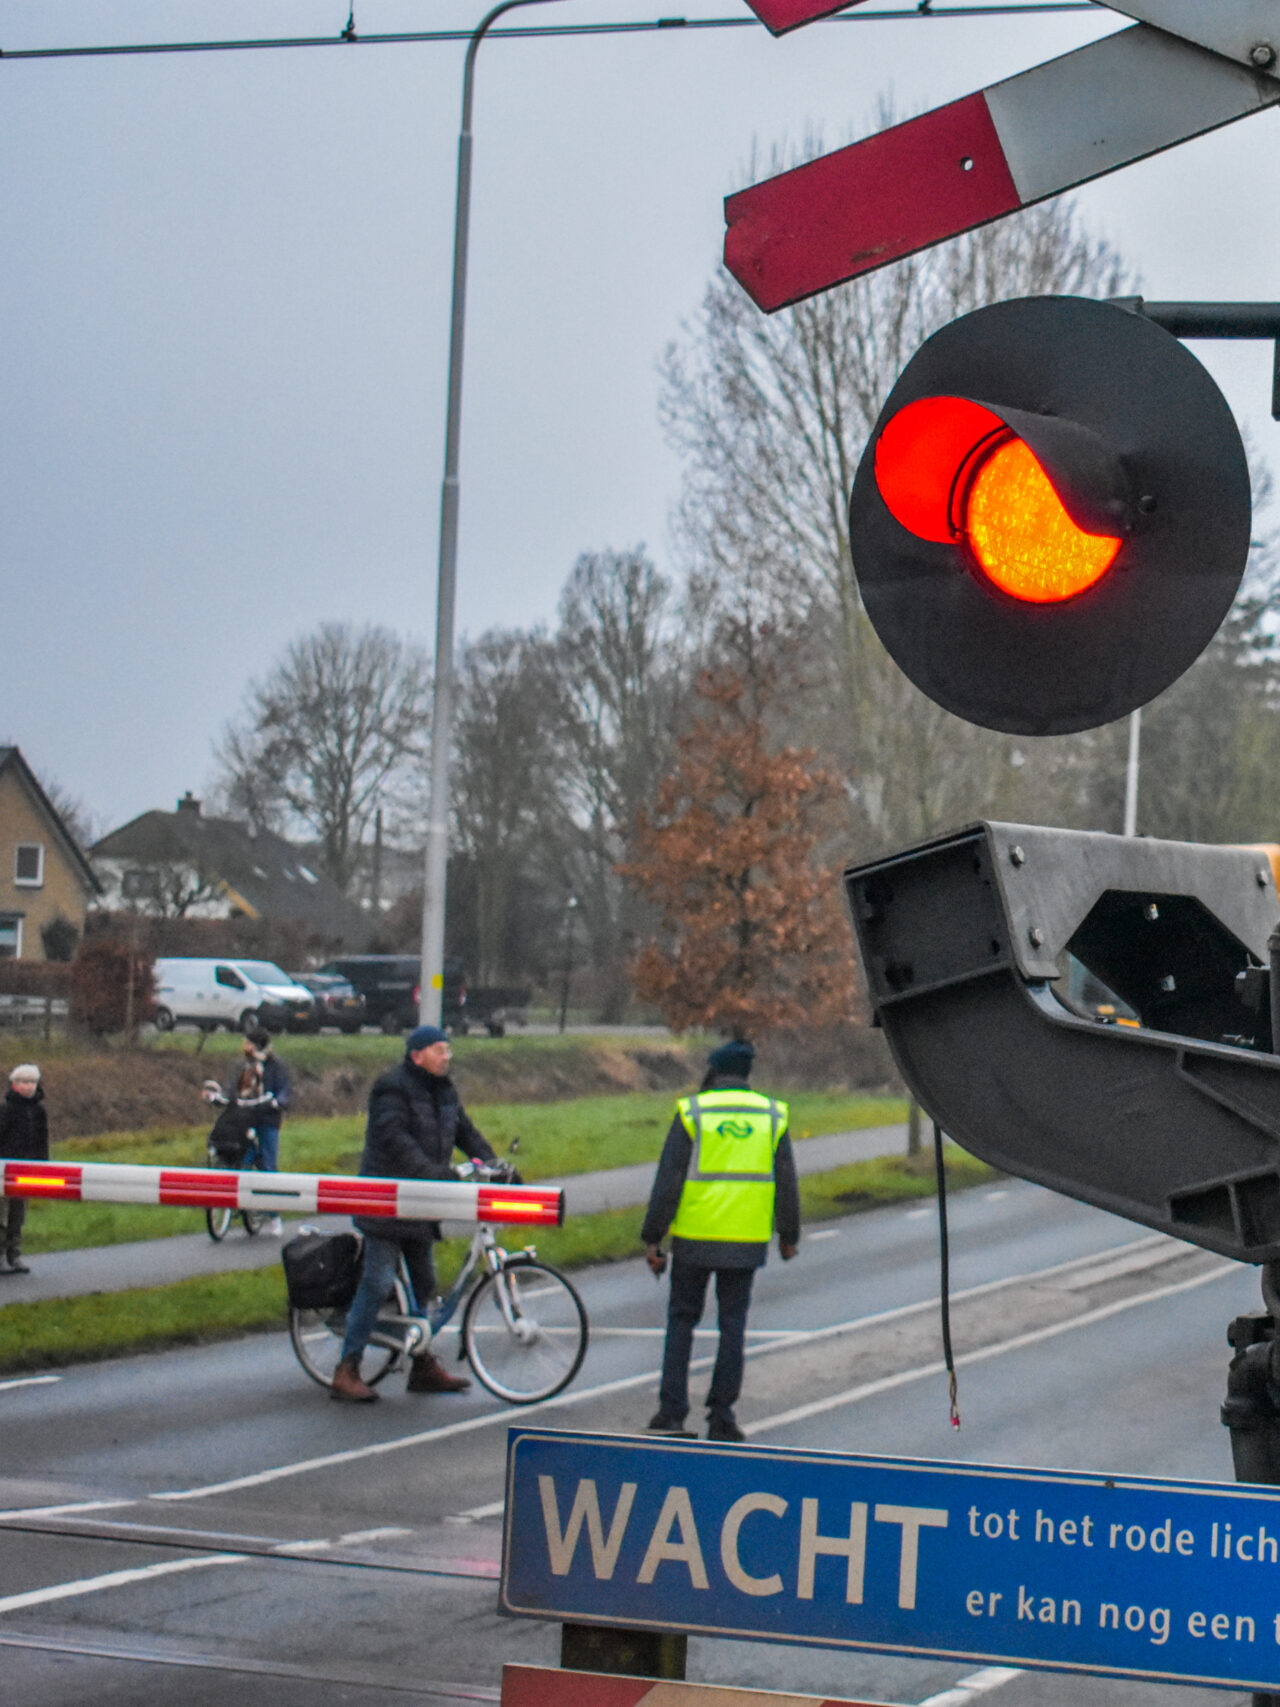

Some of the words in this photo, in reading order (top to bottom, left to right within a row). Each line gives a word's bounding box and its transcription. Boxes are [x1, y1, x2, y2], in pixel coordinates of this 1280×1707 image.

[538, 1475, 949, 1610] WACHT
[968, 1506, 1020, 1541] tot
[1036, 1509, 1094, 1547] het
[1109, 1519, 1195, 1556] rode
[966, 1590, 1003, 1617] er
[1017, 1585, 1081, 1626] kan
[1099, 1603, 1171, 1645] nog
[1187, 1611, 1255, 1642] een
